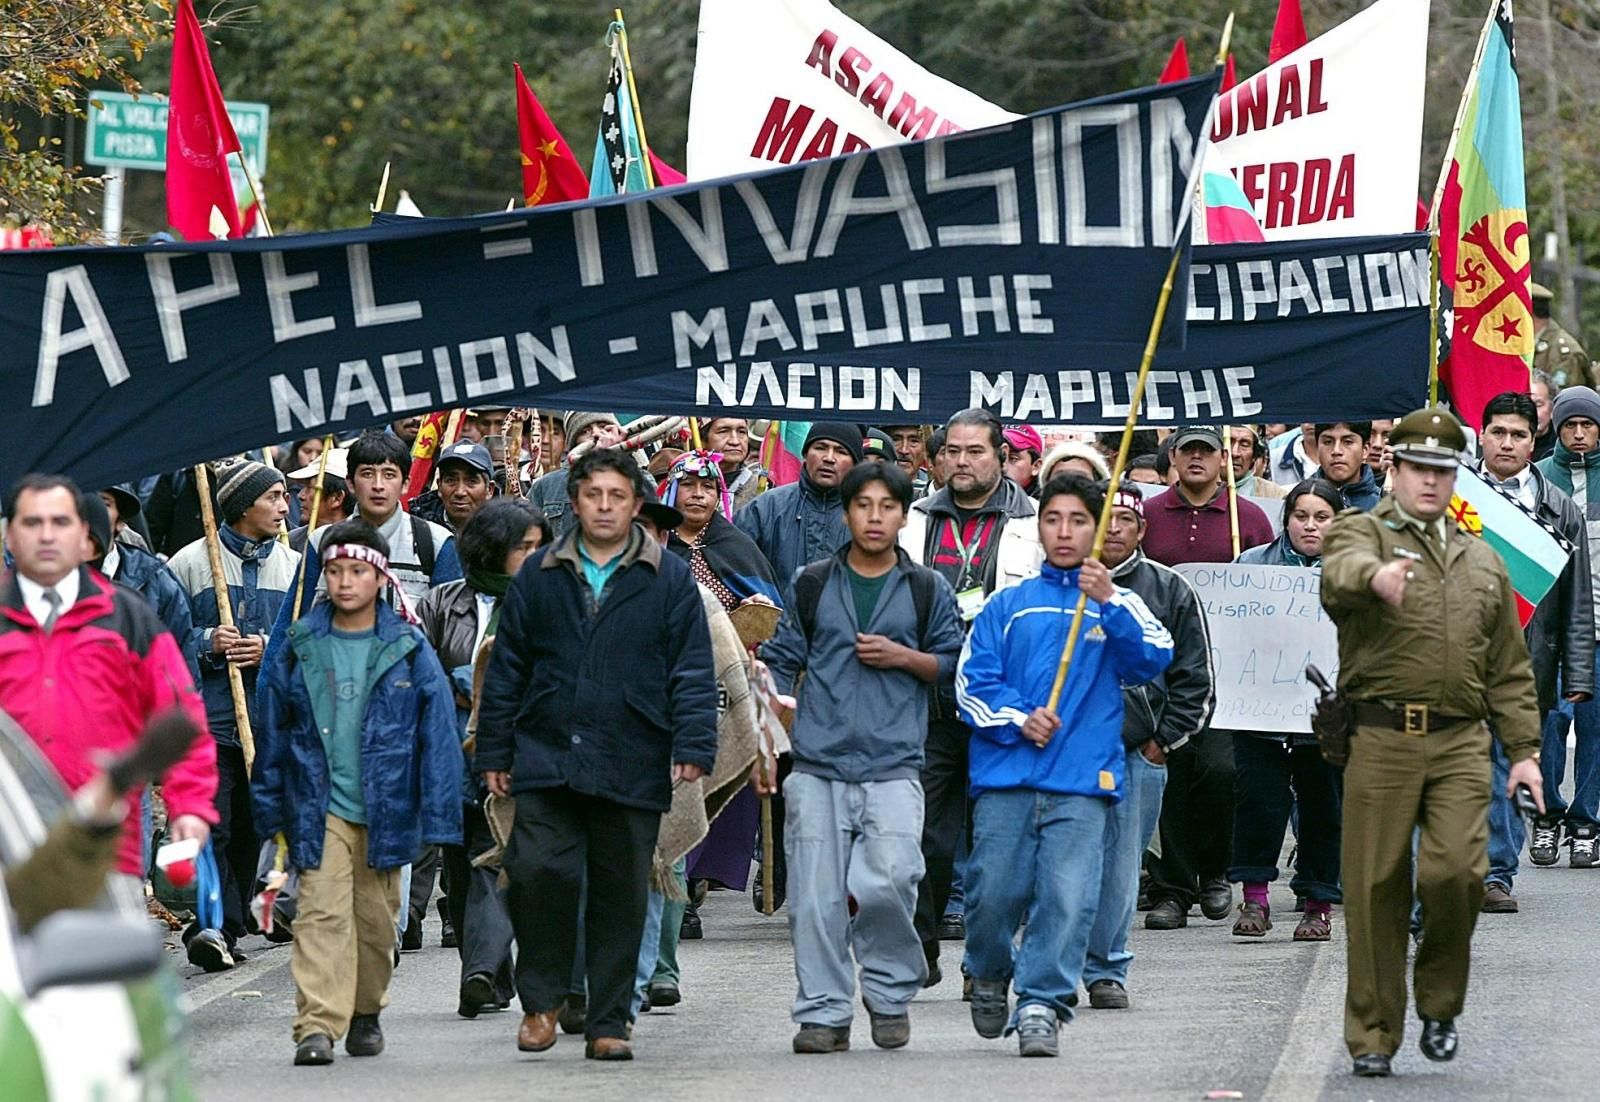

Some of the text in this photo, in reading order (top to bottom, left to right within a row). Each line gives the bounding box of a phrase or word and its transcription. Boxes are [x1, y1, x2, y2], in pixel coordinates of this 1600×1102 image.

[270, 325, 577, 433] NACION
[671, 273, 1055, 369] MAPUCHE
[696, 361, 1262, 421] NACION MAPUCHE
